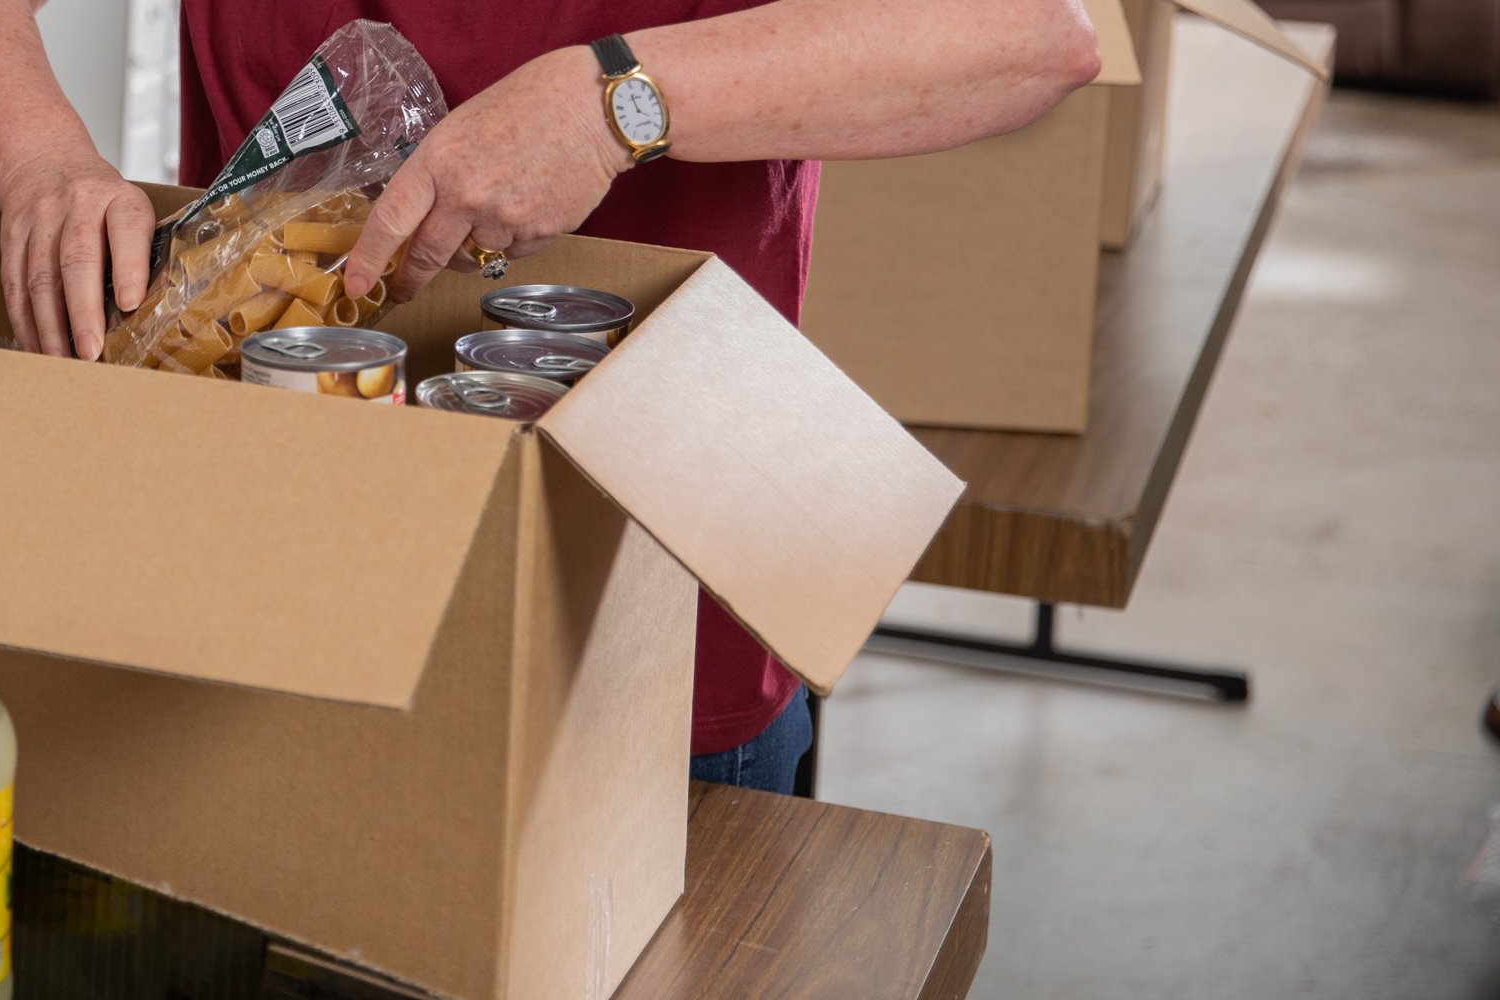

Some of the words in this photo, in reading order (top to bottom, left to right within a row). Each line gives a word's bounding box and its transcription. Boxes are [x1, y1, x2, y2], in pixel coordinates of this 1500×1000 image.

[218, 183, 229, 192] OR
[228, 176, 247, 187] YOUR
[246, 166, 269, 180] MONEY
